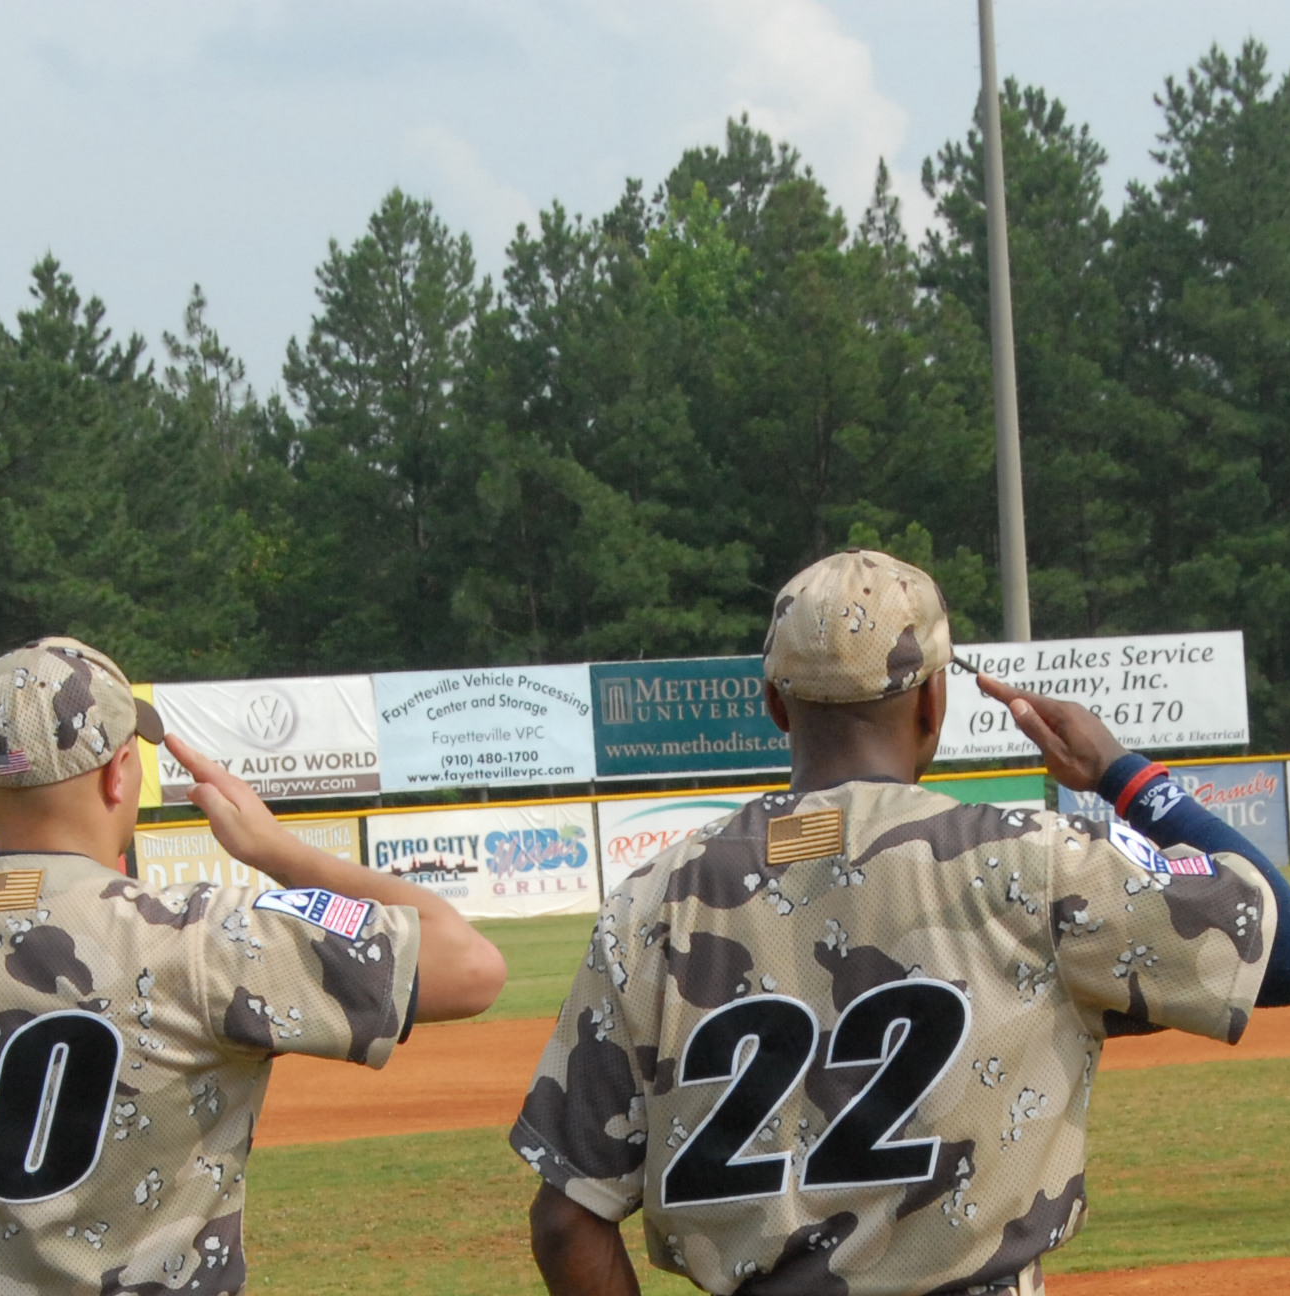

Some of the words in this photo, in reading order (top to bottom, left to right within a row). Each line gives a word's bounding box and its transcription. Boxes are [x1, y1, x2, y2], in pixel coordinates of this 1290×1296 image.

[946, 653, 1026, 679] ollege
[1035, 648, 1111, 672] Lakes
[1120, 642, 1215, 667] Service
[635, 677, 764, 703] METHOD
[1121, 670, 1169, 691] Inc.
[381, 678, 460, 723] Fayetteville
[462, 672, 514, 688] Vehicle
[518, 674, 590, 716] Processing
[426, 702, 467, 721] Center
[471, 694, 495, 708] and
[499, 693, 547, 716] Storage
[432, 727, 511, 747] Fayetteville
[514, 725, 545, 740] VPC
[959, 743, 1003, 755] Always
[1149, 732, 1172, 744] A/C
[1176, 732, 1185, 742] &
[1189, 728, 1245, 742] Electrical
[240, 755, 297, 775] AUTO
[304, 751, 377, 771] WORLD
[441, 753, 473, 768] (910)
[477, 750, 539, 765] 480-1700
[407, 765, 575, 784] www.fayettevillevpc.com
[1194, 770, 1278, 806] Family
[375, 837, 428, 867] GYRO
[434, 834, 479, 860] CITY
[492, 876, 588, 896] GRILL
[662, 977, 972, 1209] 22
